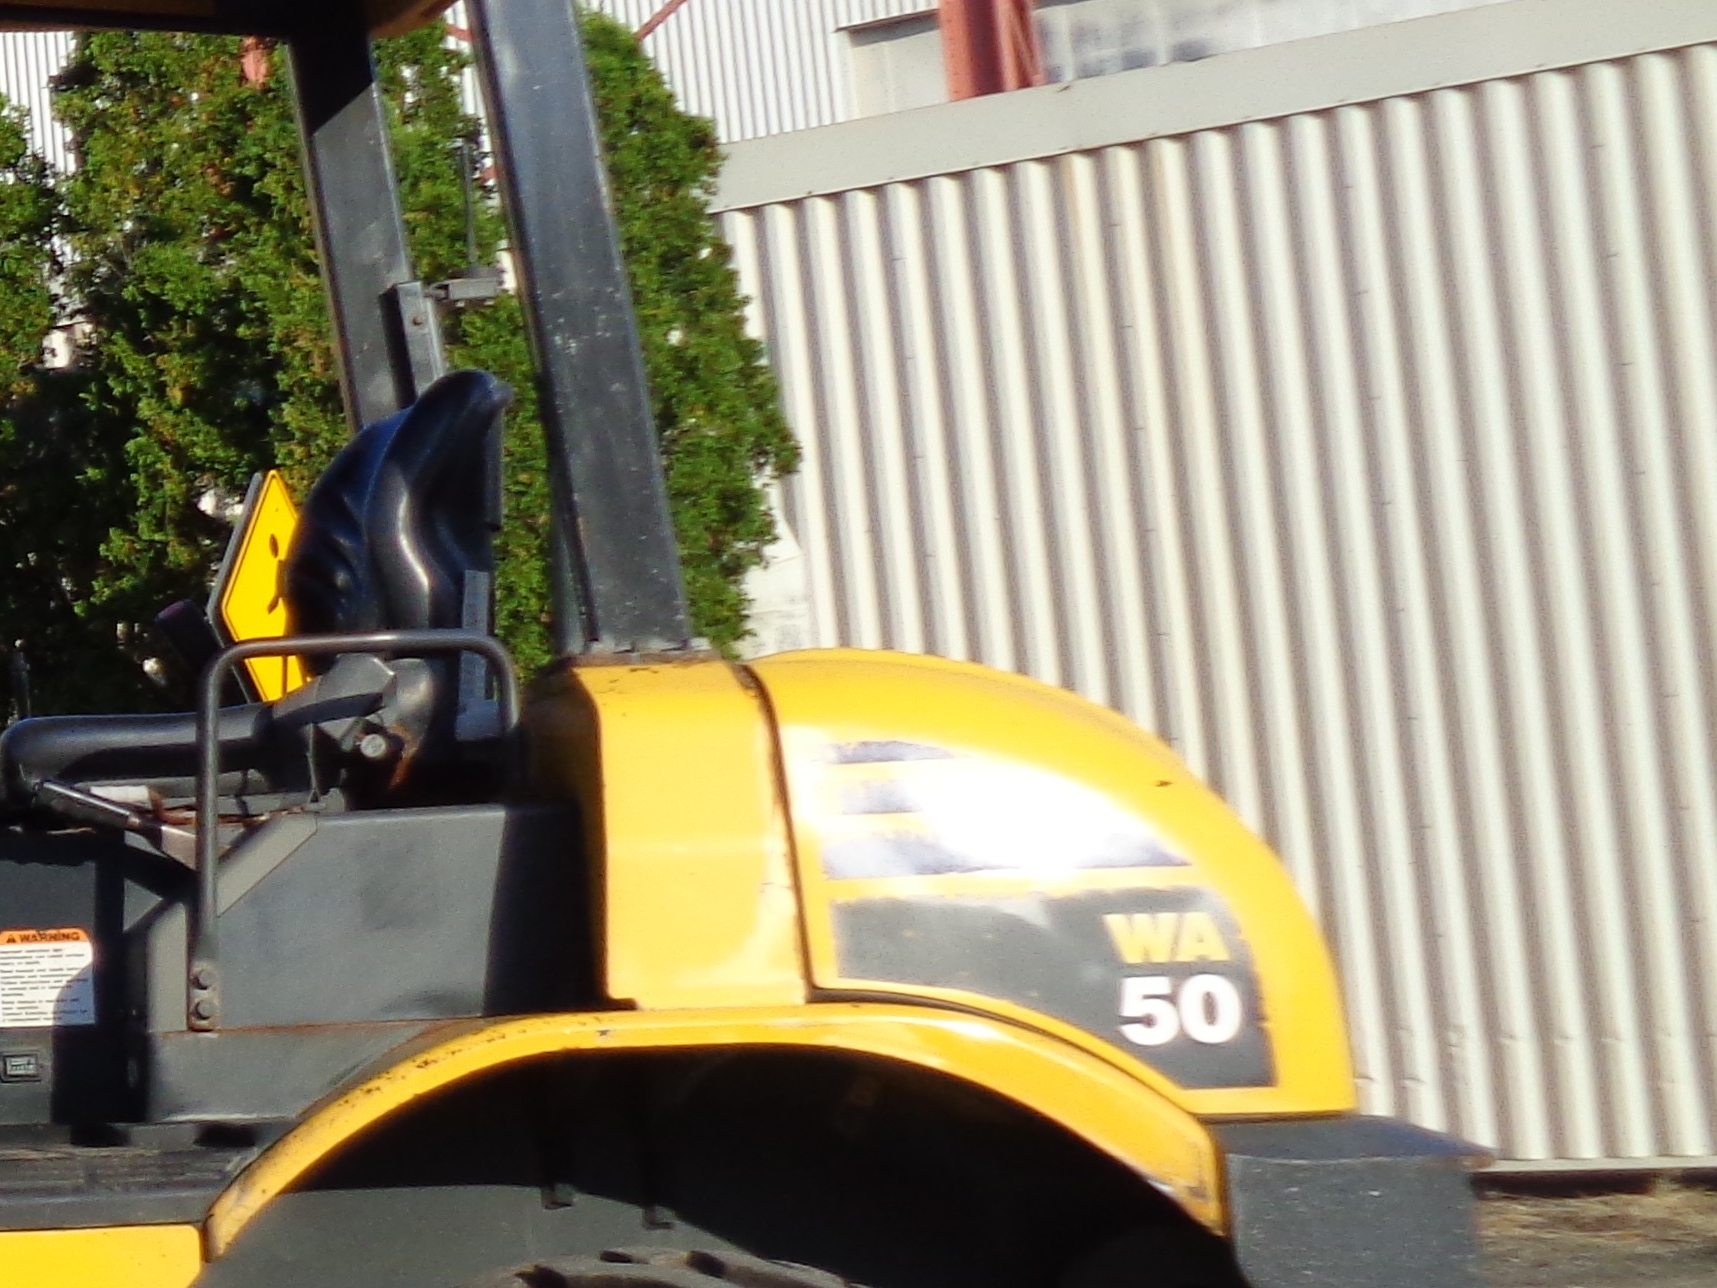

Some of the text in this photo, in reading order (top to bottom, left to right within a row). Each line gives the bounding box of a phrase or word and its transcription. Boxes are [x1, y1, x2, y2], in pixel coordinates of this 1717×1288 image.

[19, 931, 80, 942] WARNING
[1103, 911, 1231, 964] WA
[1117, 974, 1243, 1046] 50
